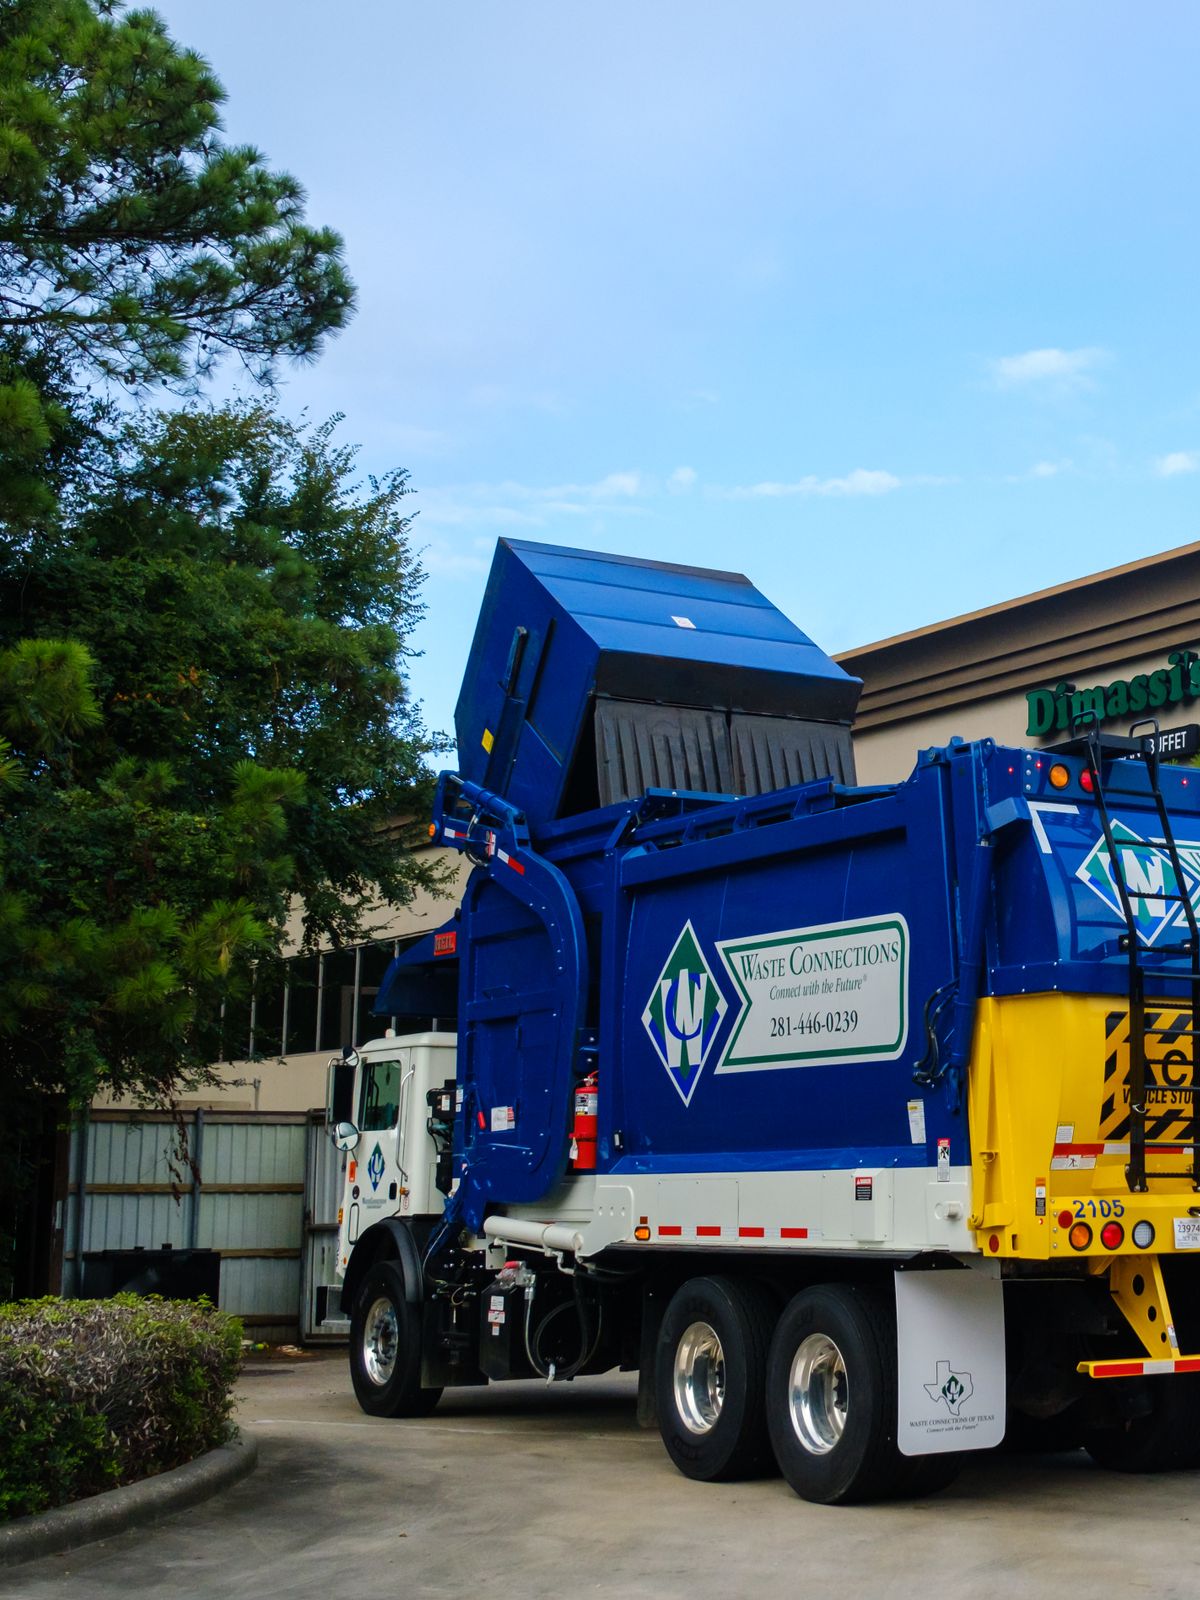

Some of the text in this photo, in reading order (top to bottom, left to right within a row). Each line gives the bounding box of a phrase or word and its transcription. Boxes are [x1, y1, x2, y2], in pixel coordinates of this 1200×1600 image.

[740, 941, 899, 981] WASTE CONNECTIONS
[769, 984, 801, 1001] Connect
[803, 980, 820, 996] with
[821, 978, 834, 994] the
[770, 1010, 858, 1037] 281-446-0239
[1122, 1087, 1168, 1104] VICLE
[1073, 1199, 1125, 1218] 2105
[928, 1417, 967, 1426] CONNECTIONS
